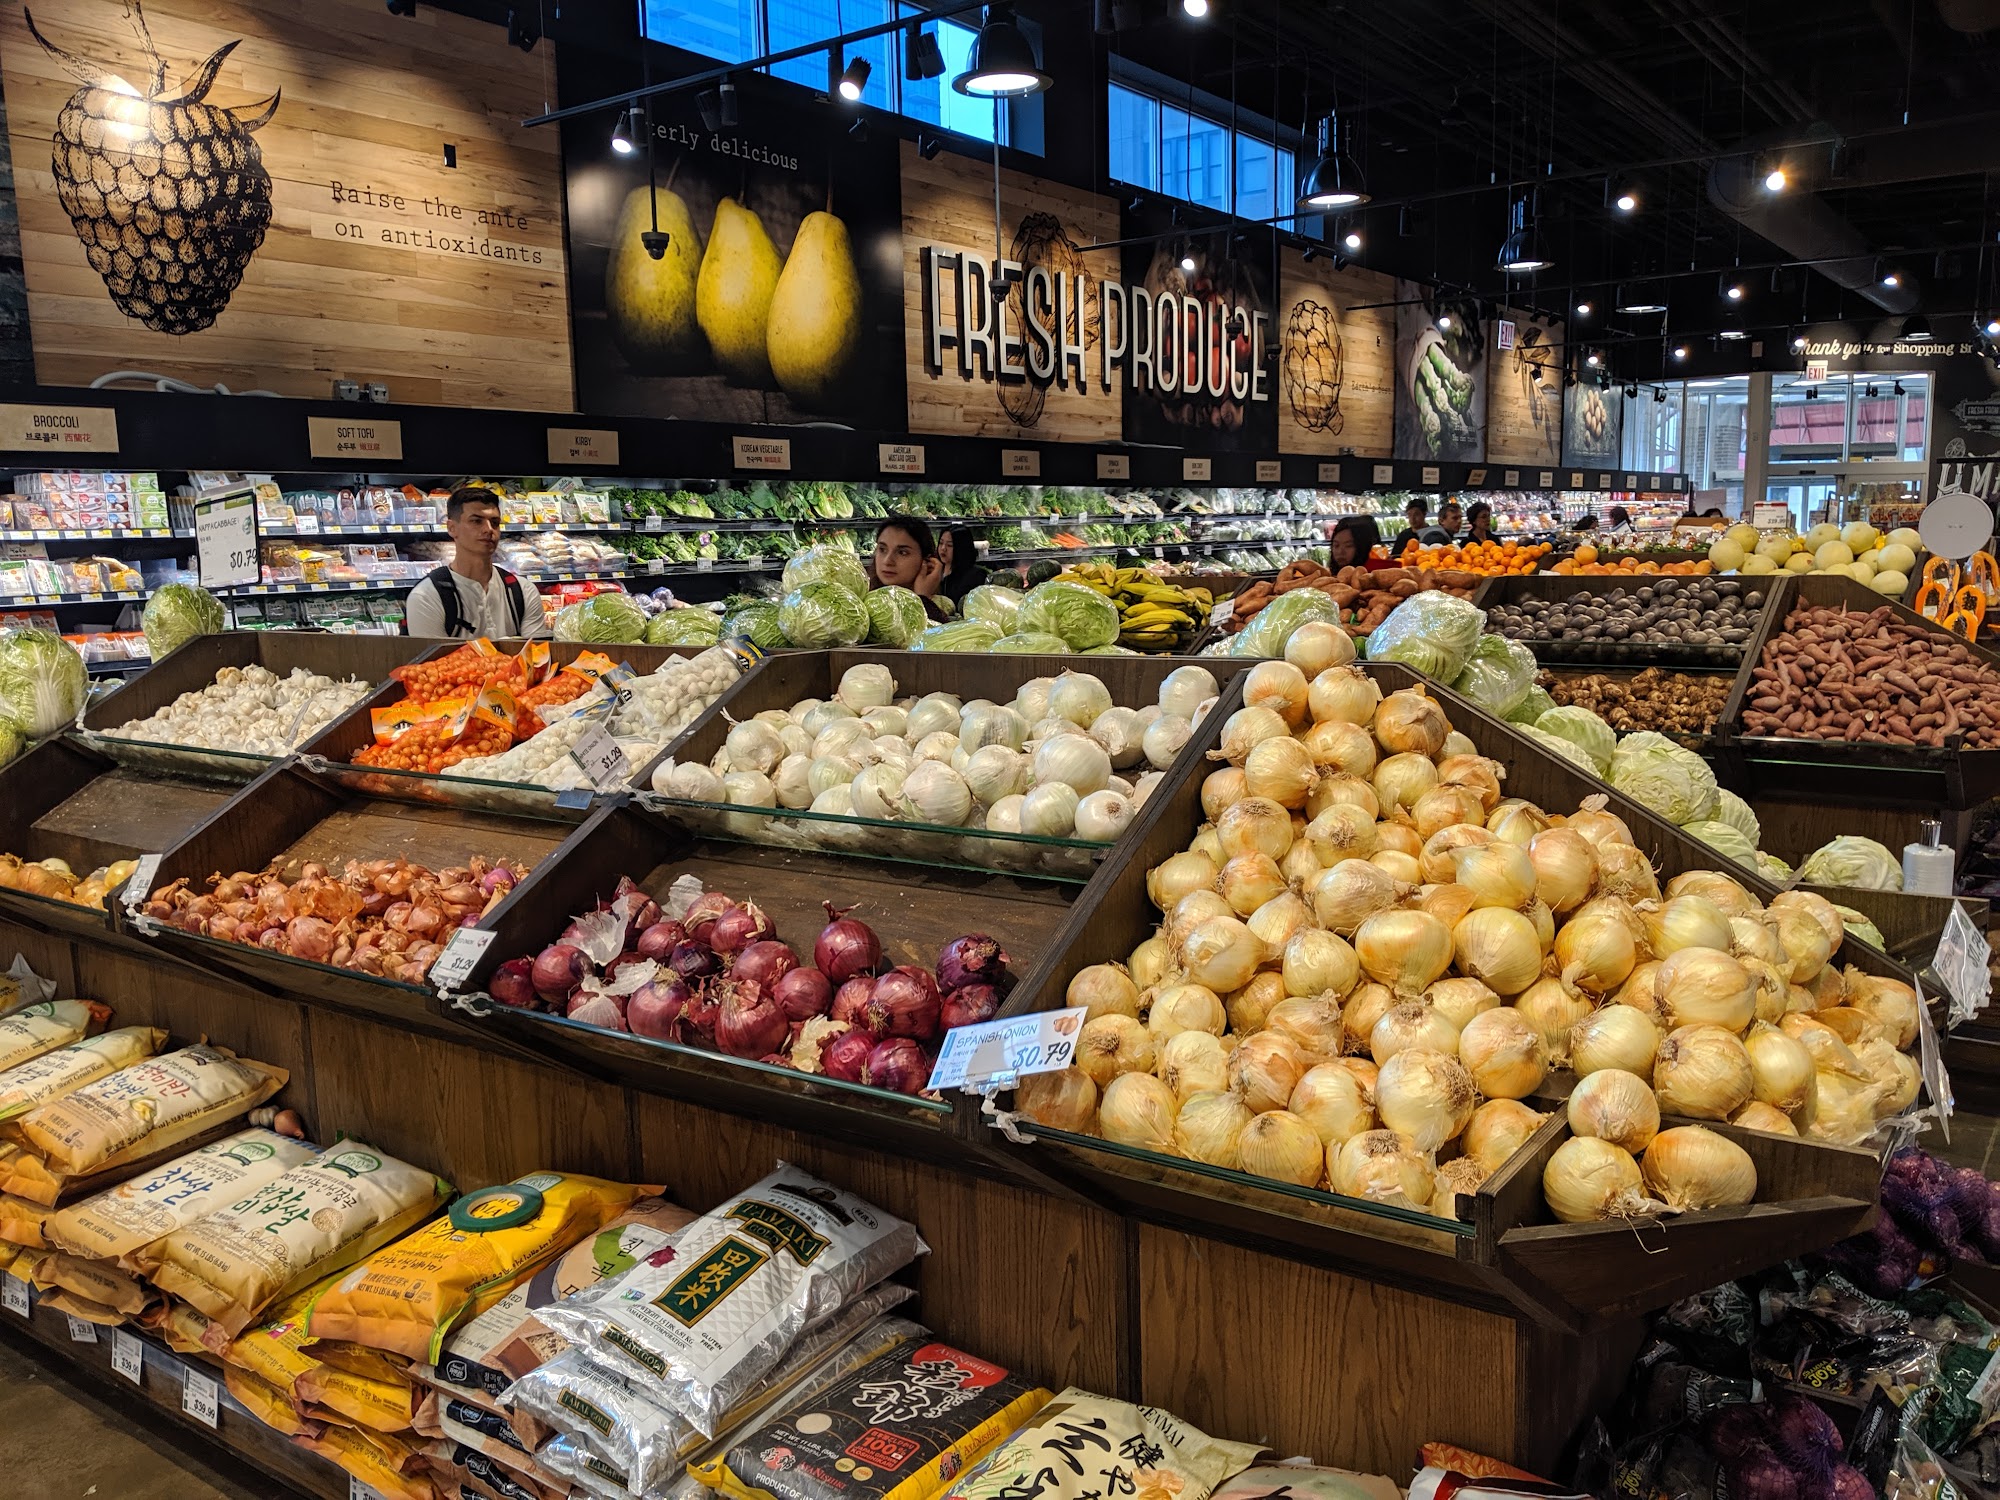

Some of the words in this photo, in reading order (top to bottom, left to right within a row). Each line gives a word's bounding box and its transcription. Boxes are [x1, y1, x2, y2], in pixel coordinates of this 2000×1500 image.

[710, 134, 799, 170] delicious
[331, 180, 406, 212] Raise
[423, 197, 462, 221] the
[477, 208, 529, 231] ante
[335, 220, 364, 241] on
[381, 225, 543, 265] antioxidants
[928, 246, 1087, 383] FRESH
[1101, 279, 1269, 401] PRODUCE
[1893, 341, 1954, 357] Shopping
[1807, 367, 1825, 380] EXIT
[33, 415, 79, 428] BROCCOLI
[337, 427, 354, 438] SOFT
[357, 428, 375, 438] TOFU
[25, 432, 59, 442] 브로콜리
[337, 442, 356, 451] 순두부
[575, 436, 591, 446] KIRBY
[760, 445, 783, 453] VEGETABLE
[230, 548, 257, 571] $0.79
[602, 746, 622, 770] $1.29
[956, 1031, 1004, 1048] SPANISH
[1004, 1023, 1039, 1038] ONION
[1012, 1041, 1071, 1070] $0.79
[56, 1077, 73, 1090] Short
[74, 1070, 91, 1081] Grain
[92, 1063, 105, 1072] Rice
[142, 1167, 213, 1206] 찹쌀
[256, 1187, 310, 1234] 찹쌀
[742, 1203, 819, 1258] TAMAKI
[750, 1223, 780, 1246] GOLD
[183, 1241, 193, 1251] NET
[271, 1244, 292, 1268] Rice
[674, 1247, 750, 1311] 田牧米
[626, 1307, 644, 1321] TAMAKI
[643, 1317, 654, 1327] RICE
[653, 1323, 687, 1349] CORPORATION
[640, 1305, 661, 1320] WEIGHT
[674, 1328, 687, 1339] 6.81
[685, 1335, 694, 1345] KG
[700, 1339, 715, 1352] FREE
[701, 1332, 723, 1350] GLUTEN
[121, 1357, 139, 1376] $39.99
[641, 1350, 664, 1371] GOLD
[194, 1399, 216, 1420] $39.99
[589, 1409, 611, 1429] GOLD
[775, 1429, 789, 1439] NET
[787, 1433, 799, 1442] WT.
[1136, 1404, 1185, 1448] GENMAI
[853, 1445, 872, 1457] JAPAN
[871, 1451, 900, 1463] GROWN
[863, 1436, 906, 1457] 100%
[755, 1473, 790, 1494] PRODUCT
[789, 1489, 801, 1500] OF
